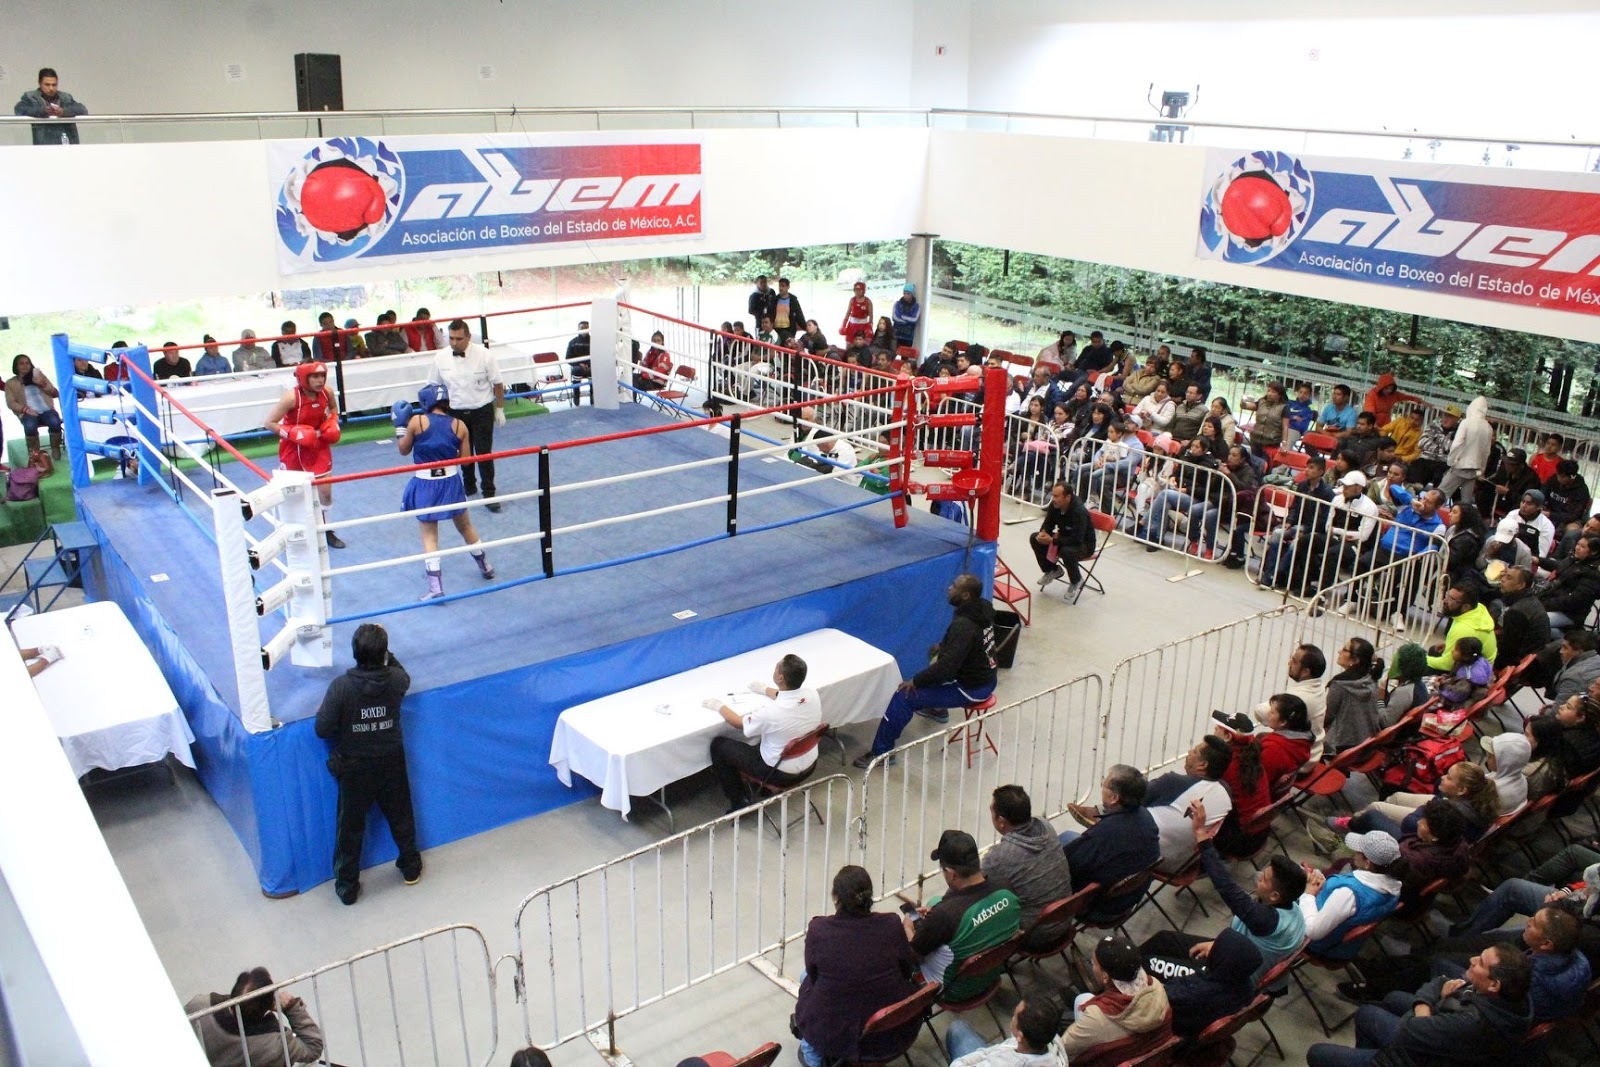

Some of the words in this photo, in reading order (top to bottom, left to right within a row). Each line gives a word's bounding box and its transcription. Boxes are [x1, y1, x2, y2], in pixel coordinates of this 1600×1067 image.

[401, 227, 476, 246] Asociación
[480, 226, 497, 240] de
[500, 224, 541, 239] Boxeo
[543, 221, 562, 236] del
[566, 219, 609, 234] Estado
[611, 218, 627, 231] de
[630, 215, 672, 230] México,
[675, 214, 697, 227] A.C.
[1298, 251, 1372, 274] Asociación
[1376, 262, 1394, 276] de
[1398, 264, 1445, 284] Boxeo
[1449, 271, 1474, 288] del
[1477, 275, 1534, 296] Estado
[1539, 283, 1561, 299] de
[361, 705, 387, 720] BOXEO
[971, 897, 1009, 927] MÉXICO
